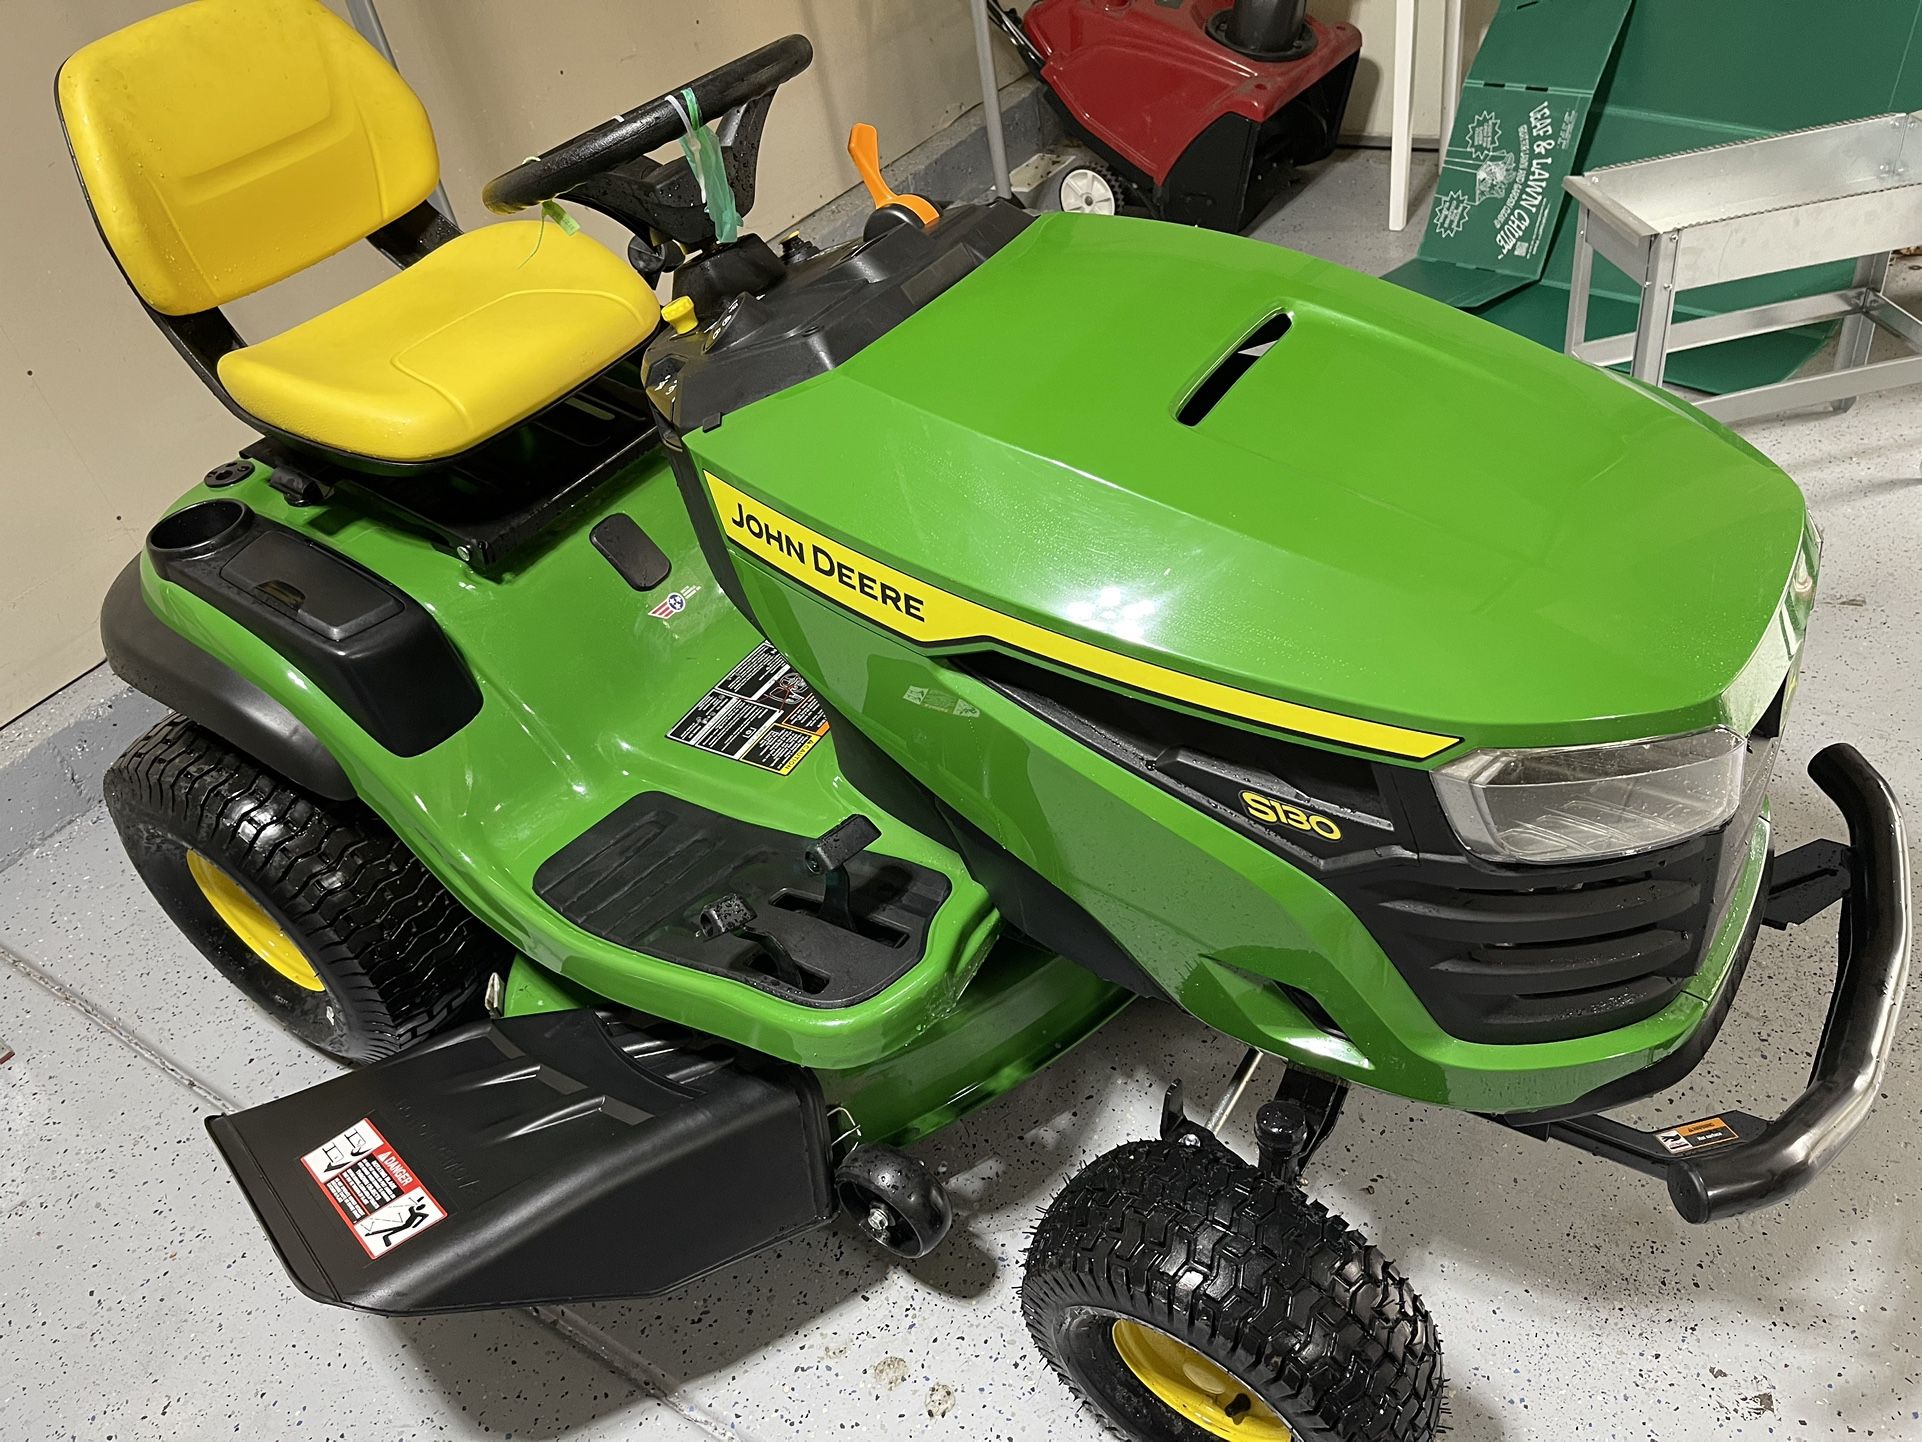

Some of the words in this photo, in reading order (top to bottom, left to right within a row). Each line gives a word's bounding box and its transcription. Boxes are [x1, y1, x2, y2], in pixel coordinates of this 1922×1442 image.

[1529, 101, 1552, 137] LEAF
[1533, 140, 1555, 155] &
[1519, 157, 1552, 213] LAWN
[1496, 209, 1530, 255] CHUTE
[732, 503, 805, 565] JOHN
[812, 543, 925, 622] DEERE
[785, 744, 809, 770] CAUTION
[1242, 791, 1341, 840] S130
[384, 1156, 413, 1186] DANGER
